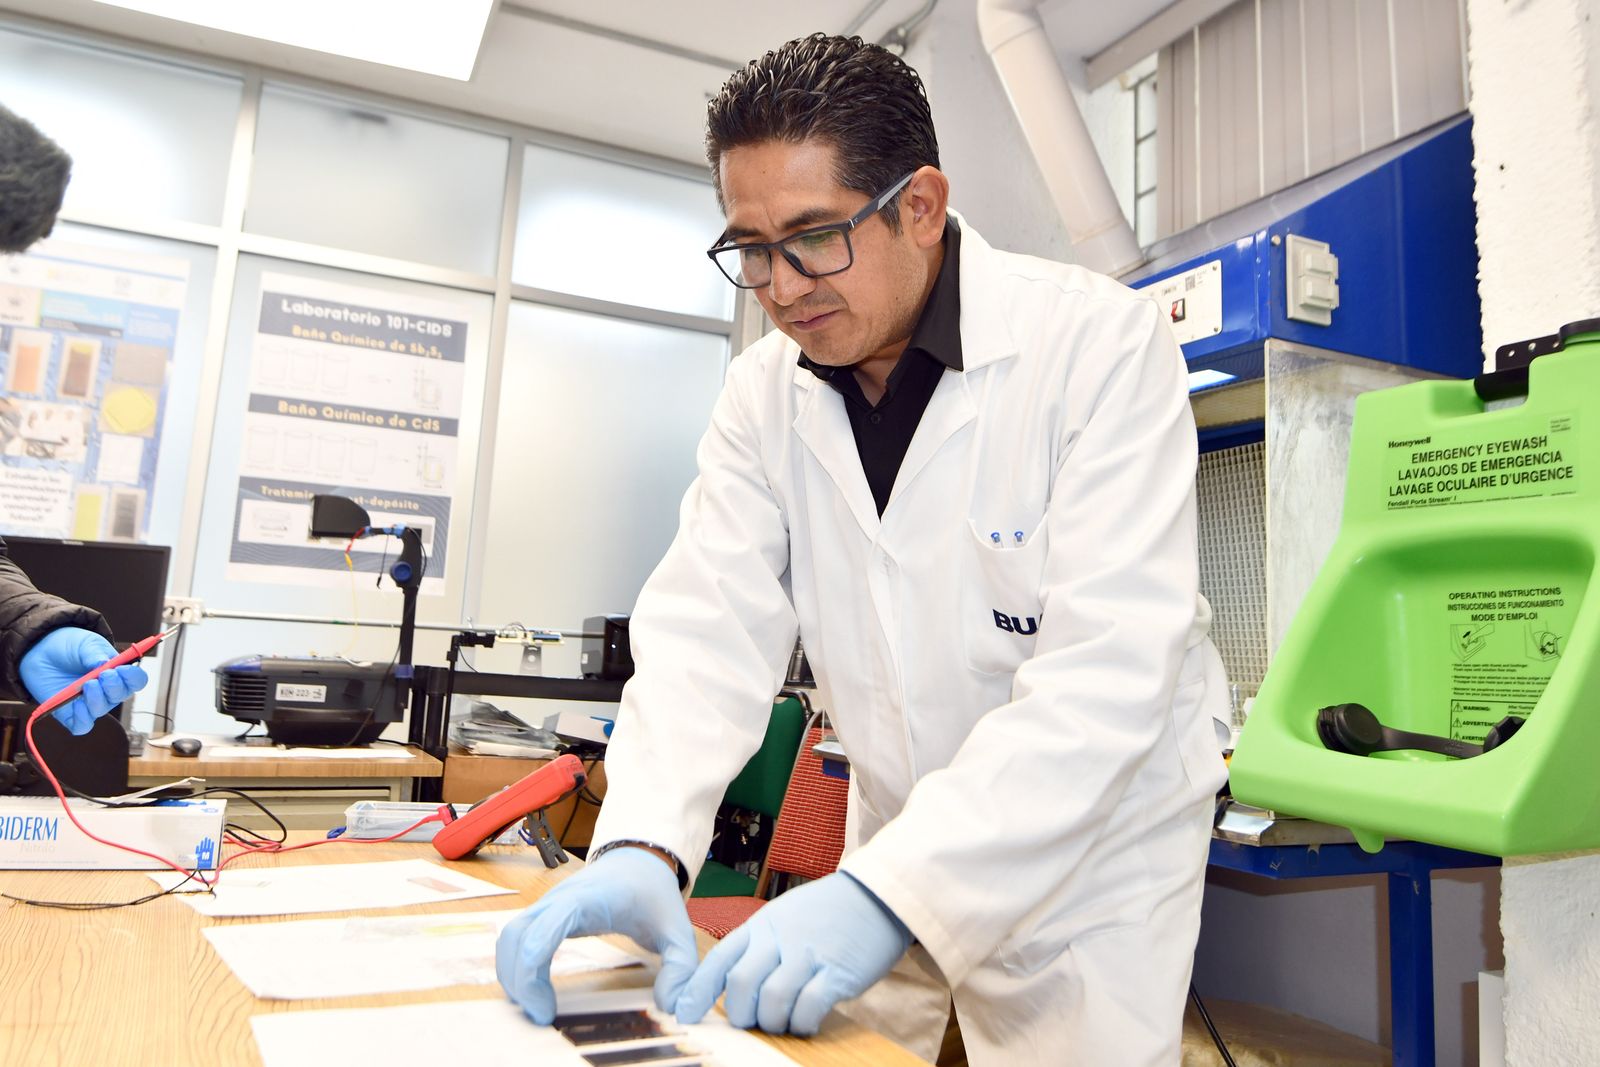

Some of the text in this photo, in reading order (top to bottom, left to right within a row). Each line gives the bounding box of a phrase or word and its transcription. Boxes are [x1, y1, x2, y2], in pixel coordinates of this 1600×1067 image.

[281, 299, 381, 326] Laboratorio
[292, 325, 327, 341] Baño
[331, 331, 386, 350] Químico
[390, 340, 406, 353] de
[278, 400, 441, 432] Baño Químico de CdS
[1388, 436, 1431, 448] Honeywell
[1411, 435, 1548, 464] EMERGENCY EYEWASH
[1398, 450, 1562, 480] LAVAOJOS DE EMERGENCIA
[1389, 466, 1574, 497] LAVAGE OCULAIRE D'URGENCE
[1447, 602, 1497, 611] INSTRUCCIONES
[1508, 599, 1564, 609] FUNCIONAMIENTO
[1448, 587, 1561, 600] OPERATING INSTRUCTIONS
[992, 608, 1043, 635] BU
[1471, 612, 1538, 621] MODE D'EMPLOI
[201, 851, 210, 860] M
